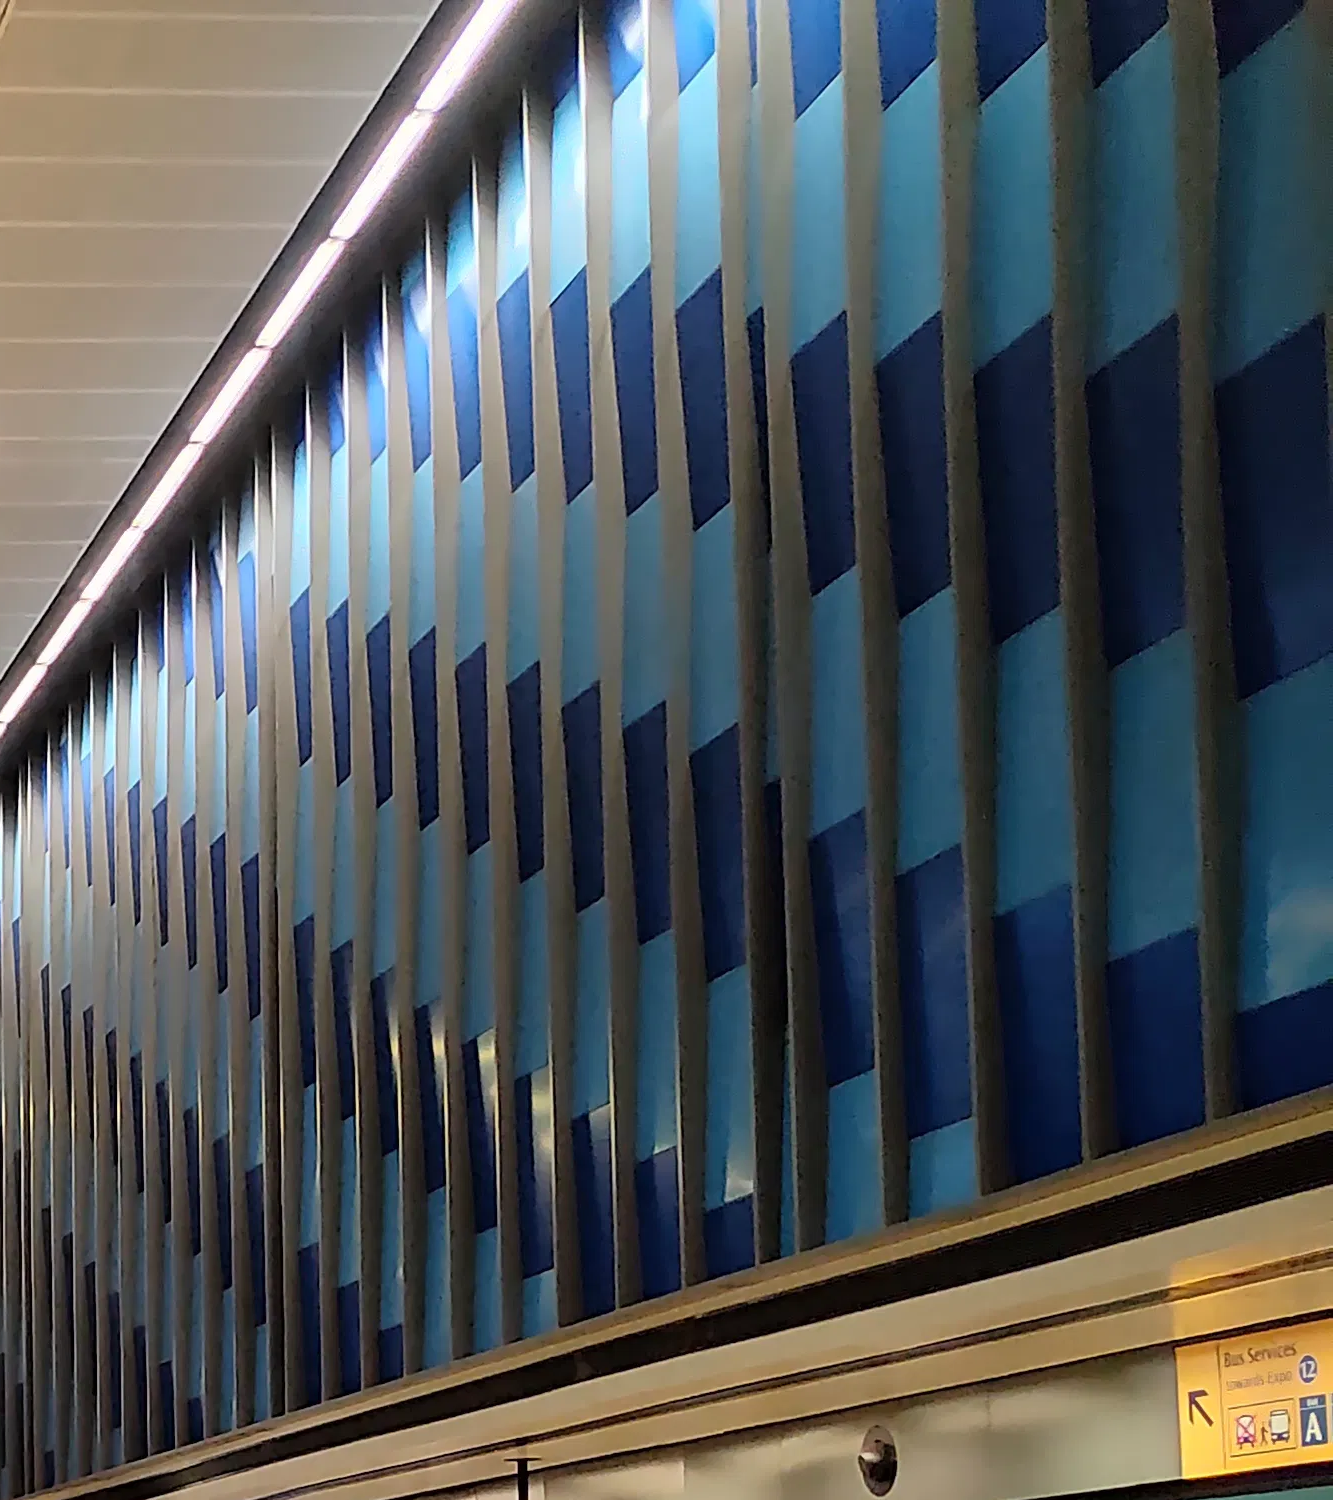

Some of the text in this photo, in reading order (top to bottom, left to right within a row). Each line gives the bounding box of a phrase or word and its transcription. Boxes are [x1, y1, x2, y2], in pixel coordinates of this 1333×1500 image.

[1224, 1343, 1297, 1368] Bus Services
[1268, 1371, 1293, 1388] Expo
[1300, 1361, 1317, 1378] 12
[1304, 1412, 1323, 1442] A
